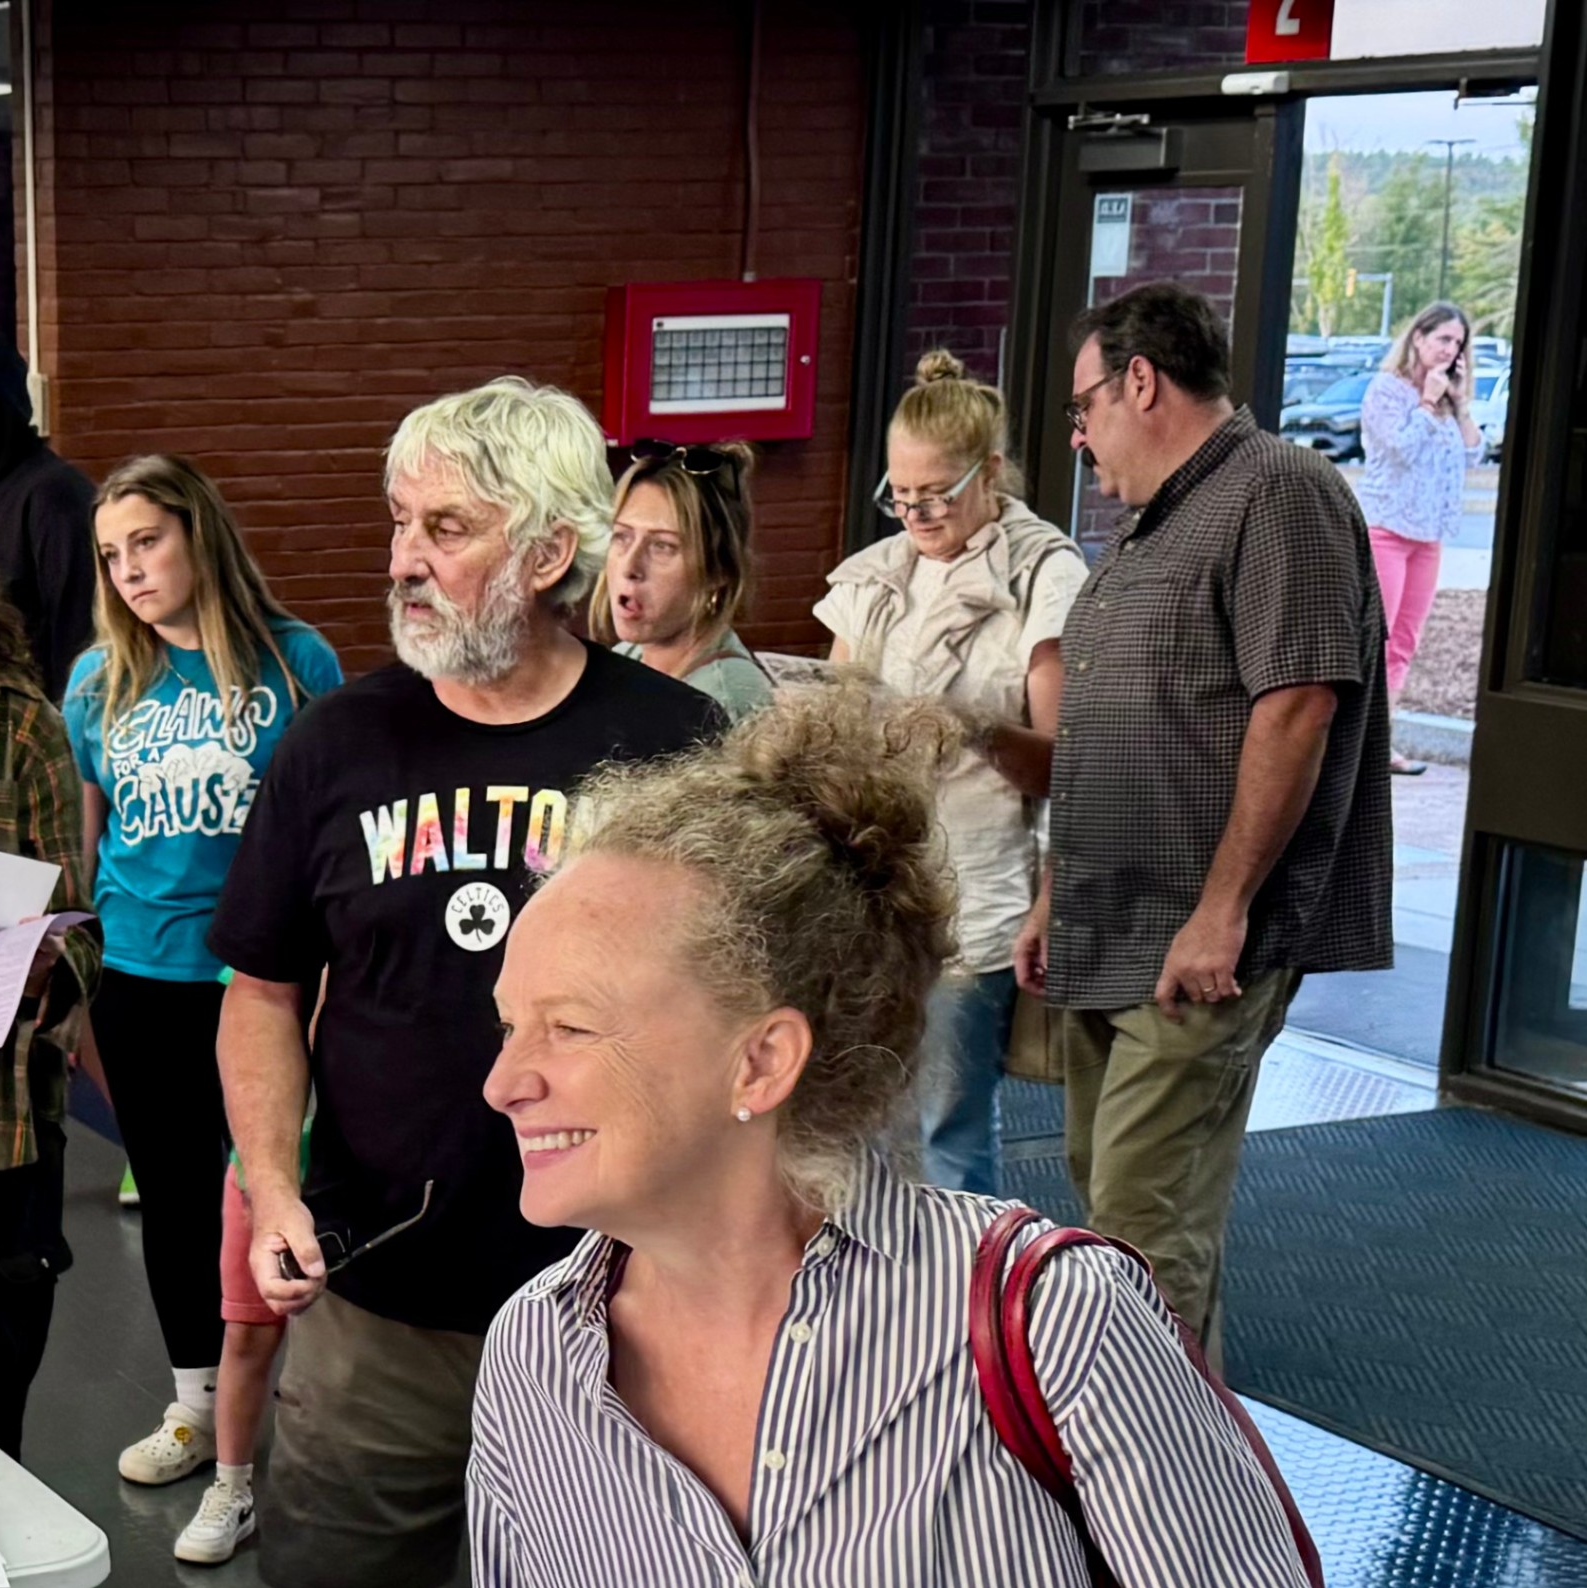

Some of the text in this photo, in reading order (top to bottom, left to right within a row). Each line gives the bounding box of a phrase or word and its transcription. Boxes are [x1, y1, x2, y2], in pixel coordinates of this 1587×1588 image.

[108, 686, 277, 758] CLAWS
[113, 748, 159, 779] FOR A
[114, 772, 260, 847] CAUSE
[451, 887, 505, 914] CELTICS
